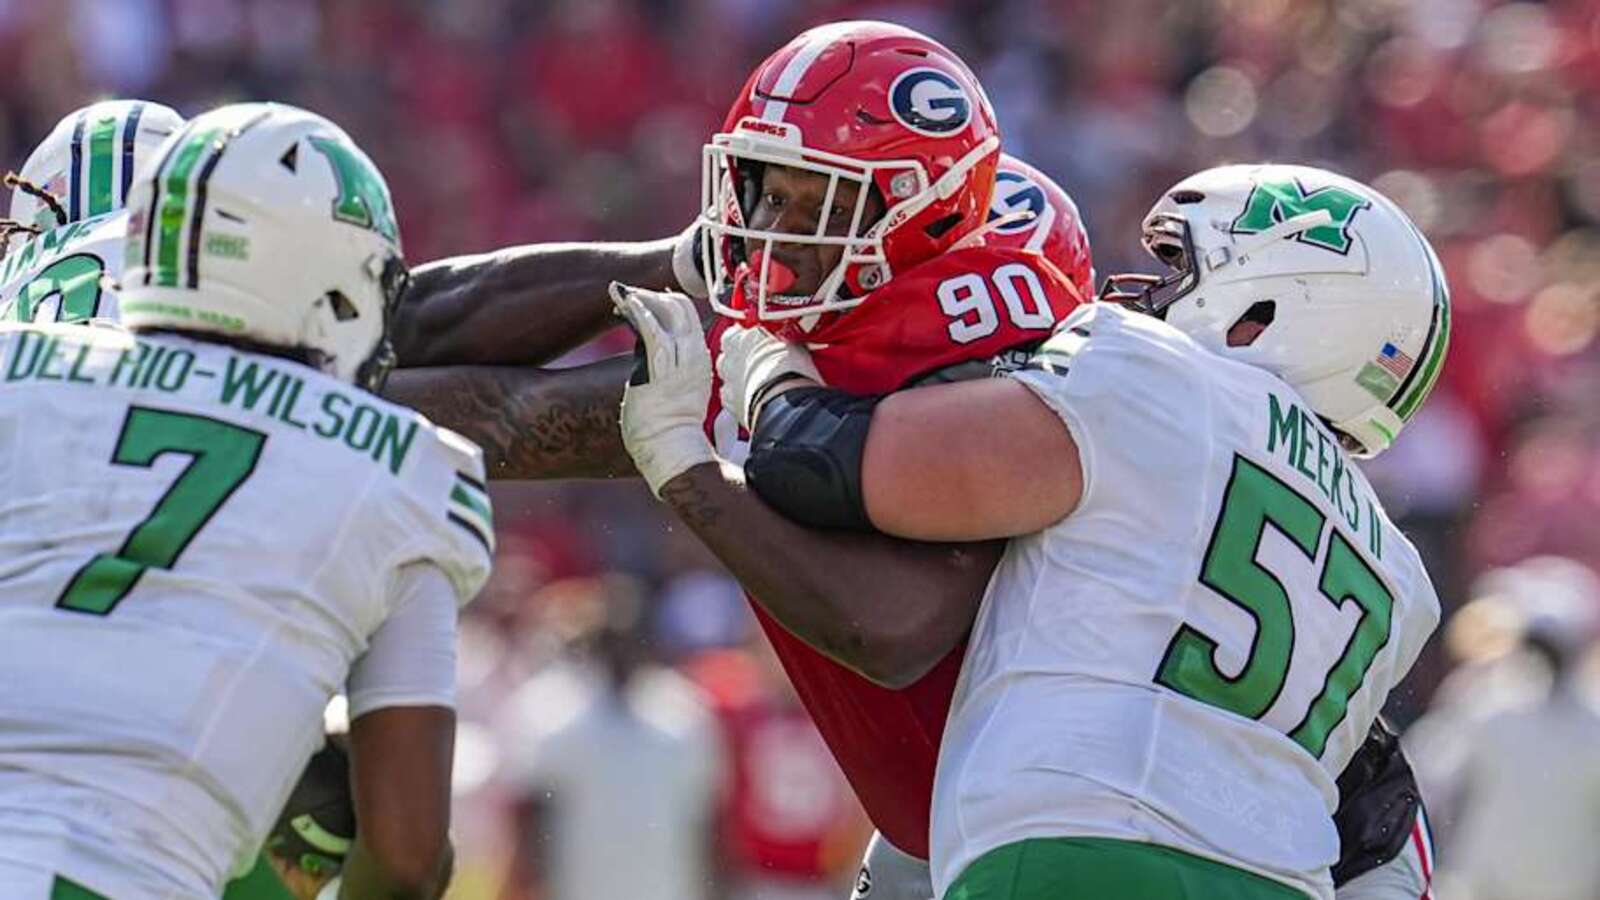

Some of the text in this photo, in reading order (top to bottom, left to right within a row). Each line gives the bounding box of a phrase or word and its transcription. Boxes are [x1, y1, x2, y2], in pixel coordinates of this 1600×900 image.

[890, 68, 971, 136] G
[1231, 176, 1374, 256] M
[936, 263, 1055, 344] 90
[4, 330, 95, 384] DEL
[106, 335, 420, 476] RIO-WILSON
[55, 404, 269, 617] 7
[1267, 392, 1382, 562] MEEKS II
[1152, 451, 1395, 761] 57
